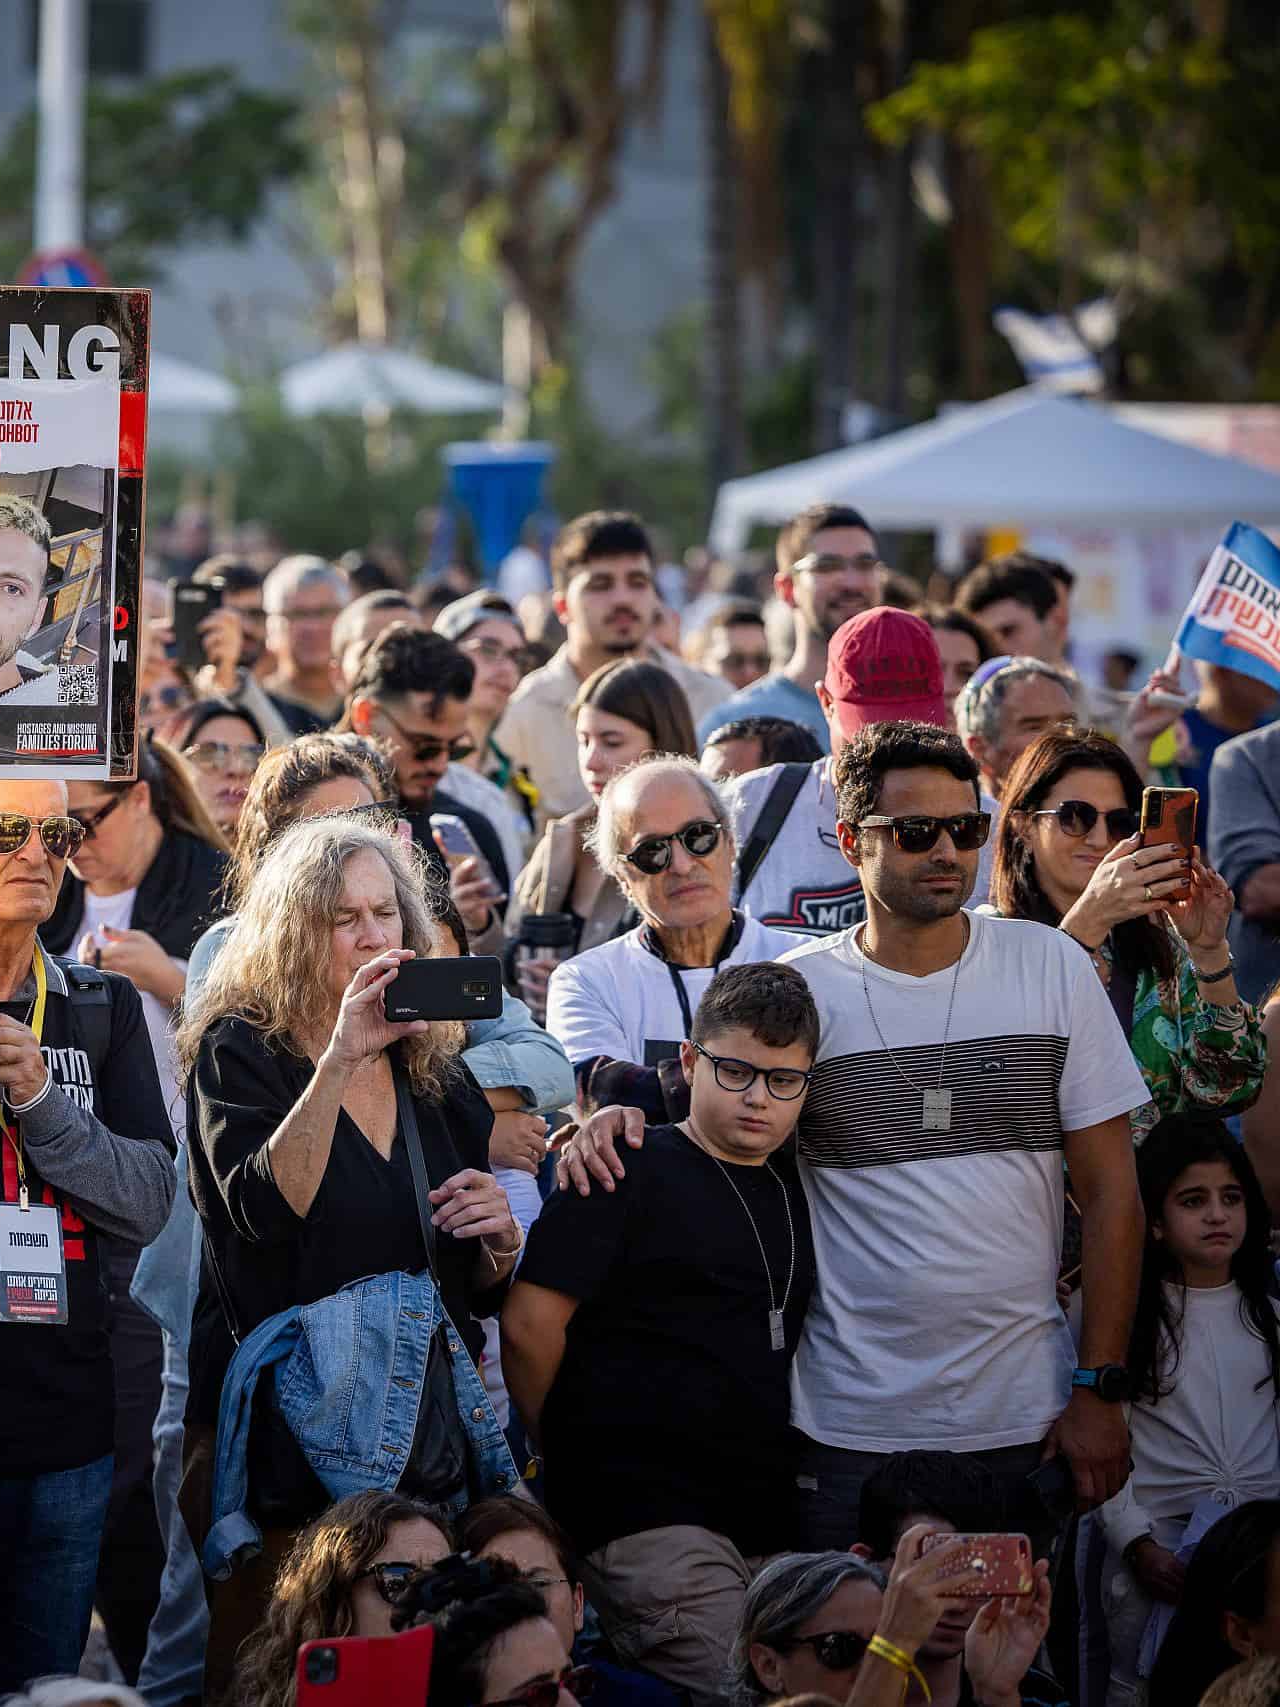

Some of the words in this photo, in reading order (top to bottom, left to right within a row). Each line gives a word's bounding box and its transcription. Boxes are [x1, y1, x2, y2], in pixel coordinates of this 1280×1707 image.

[17, 722, 52, 734] HOSTAGES
[52, 723, 66, 734] AND
[66, 723, 97, 734] MISSING
[17, 734, 60, 750] FAMILIES
[62, 734, 97, 750] FORUM
[9, 1232, 49, 1248] משפחות
